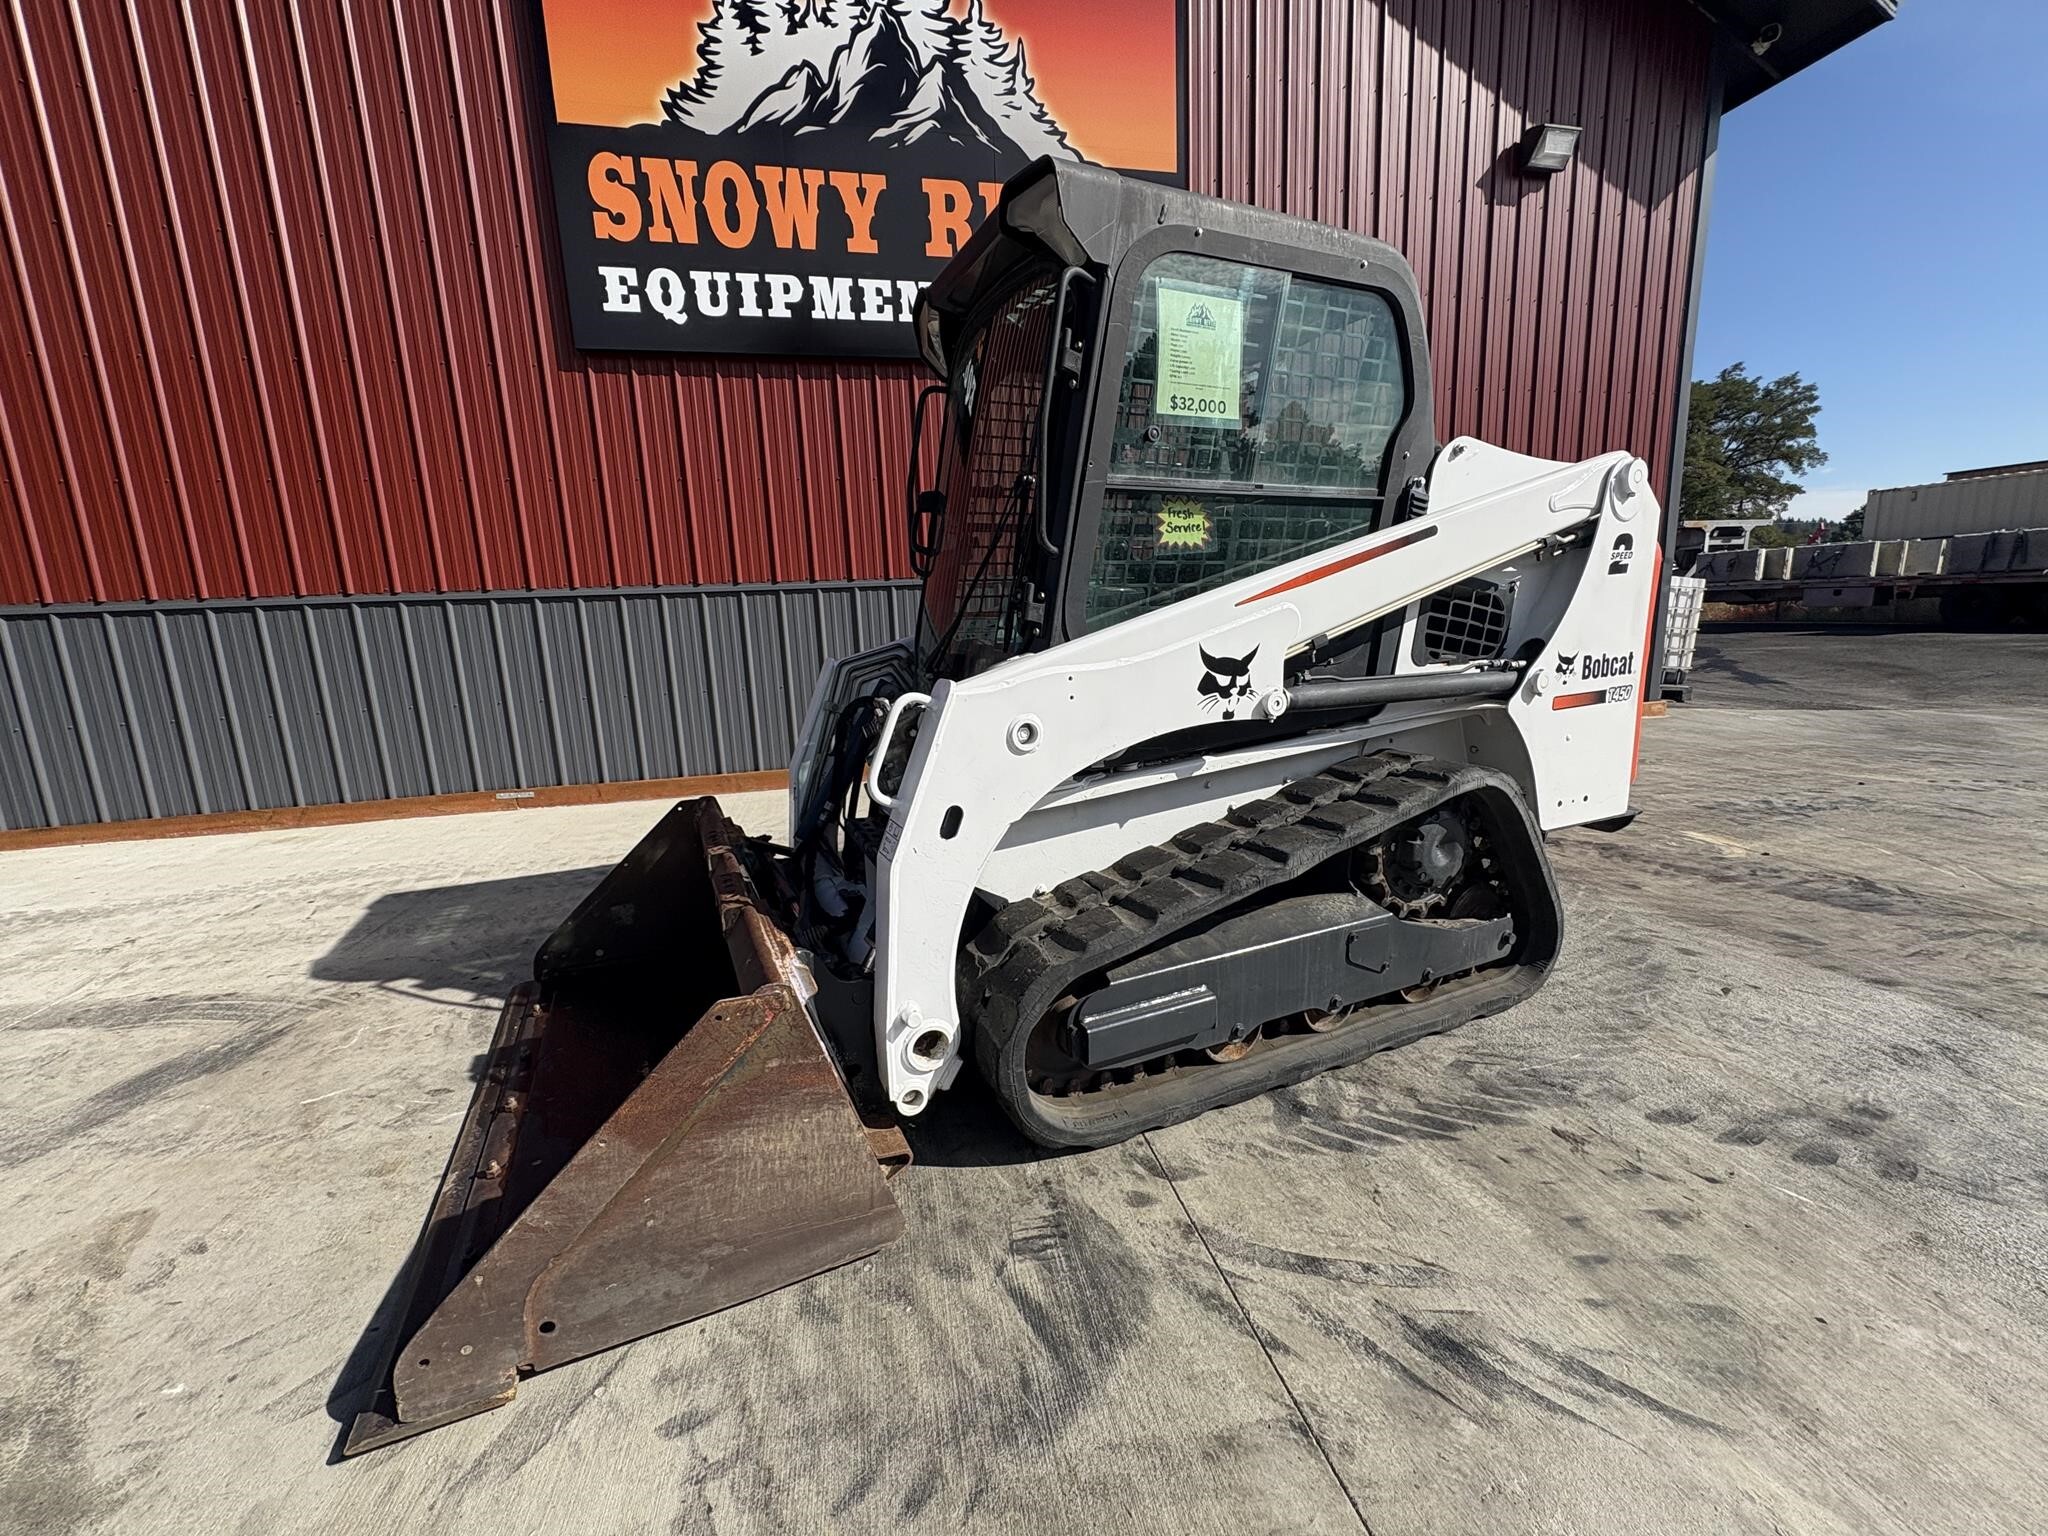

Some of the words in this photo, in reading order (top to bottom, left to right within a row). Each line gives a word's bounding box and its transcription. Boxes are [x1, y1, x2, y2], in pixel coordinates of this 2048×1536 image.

[588, 152, 887, 254] SNOWY
[1170, 394, 1226, 414] $32,000
[1168, 507, 1194, 520] Fresh
[1165, 520, 1206, 535] Service!
[1610, 551, 1633, 560] SPEED
[1582, 651, 1634, 680] Bobcat
[1608, 684, 1633, 703] T450
